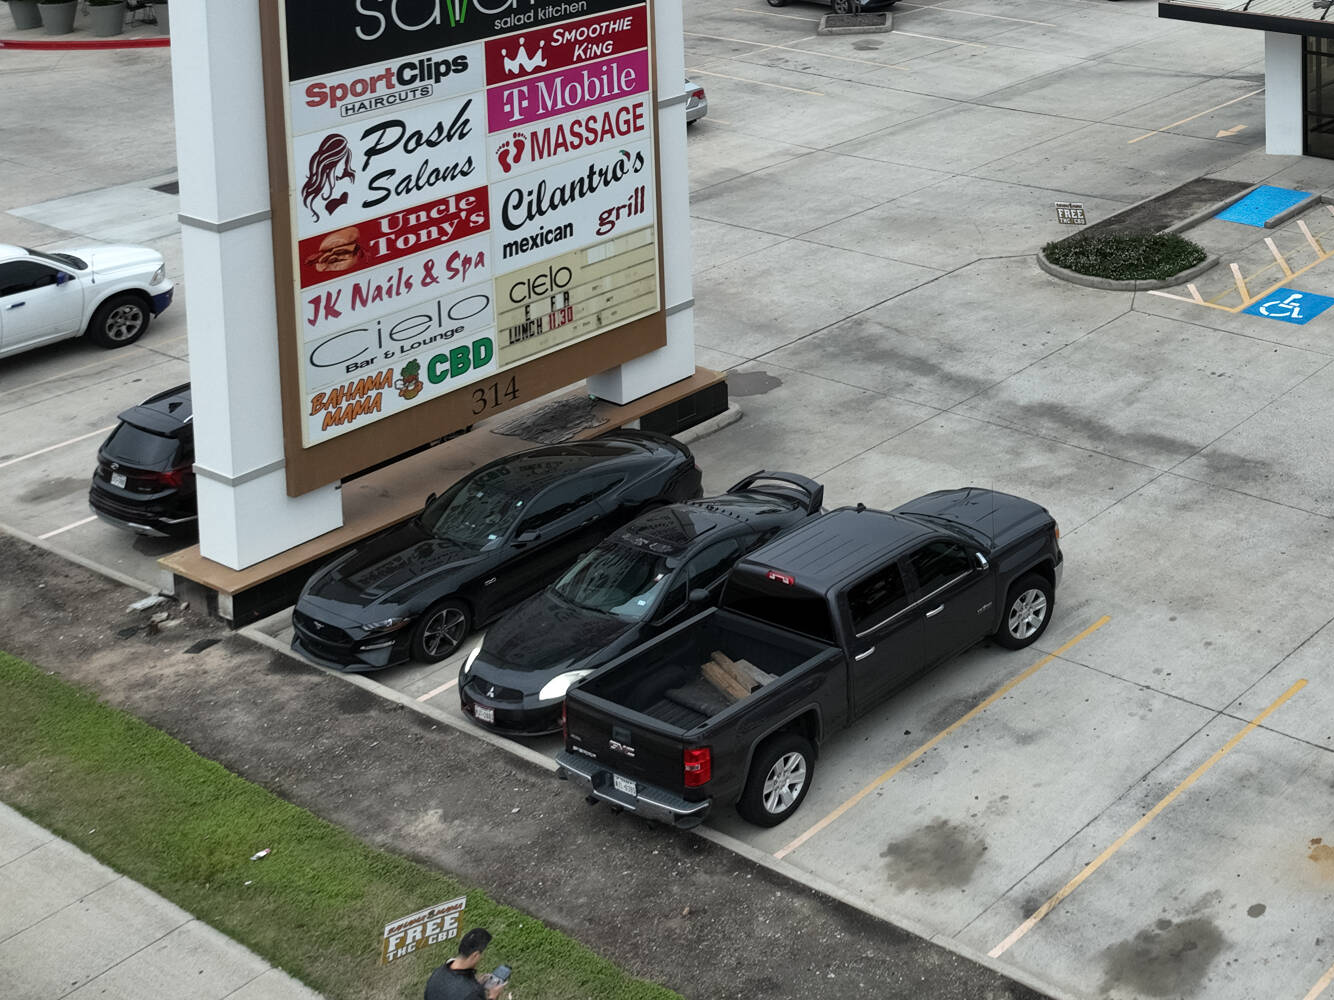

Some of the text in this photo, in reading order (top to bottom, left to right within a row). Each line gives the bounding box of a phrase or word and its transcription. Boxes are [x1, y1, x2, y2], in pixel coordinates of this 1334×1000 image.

[494, 0, 588, 31] salad kitchen
[550, 16, 633, 47] SMOOTHIE
[344, 85, 432, 118] HAIRCUTS
[535, 62, 637, 115] Mobile
[359, 98, 474, 172] Posh
[530, 101, 645, 162] MASSAGE
[361, 154, 476, 209] Salons
[501, 149, 646, 232] Cilantro's
[368, 208, 486, 259] Tony's
[377, 193, 478, 235] Uncle
[502, 184, 646, 259] mexican grill
[1057, 208, 1084, 218] FREE
[307, 248, 487, 327] JK Nails & Spa
[345, 325, 466, 374] Bar & Lounge
[508, 317, 544, 345] LUNCH
[309, 336, 495, 417] BAHAMA CBD
[470, 375, 521, 416] 314
[320, 392, 384, 431] MAMA
[386, 928, 458, 962] THC CBD
[387, 912, 460, 953] FREE
